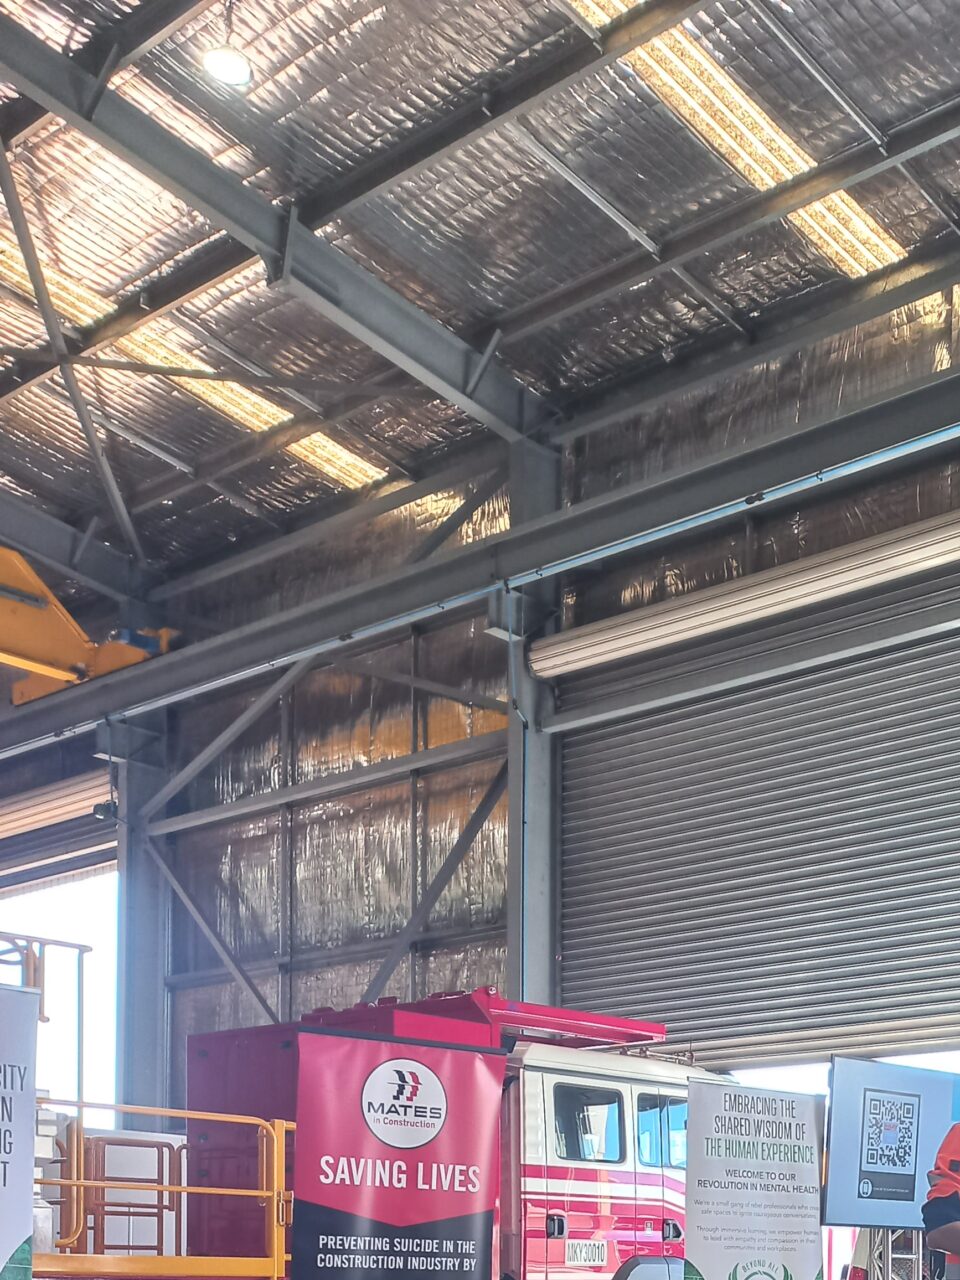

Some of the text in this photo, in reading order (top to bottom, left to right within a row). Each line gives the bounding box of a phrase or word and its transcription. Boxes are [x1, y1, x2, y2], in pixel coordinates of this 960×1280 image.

[0, 1064, 27, 1092] ITY
[367, 1101, 442, 1120] MATES
[724, 1092, 796, 1118] EMBRACING THE
[383, 1117, 436, 1129] Construction
[714, 1115, 806, 1141] SHARED WISDOM OF
[704, 1137, 814, 1164] THE HUMAN EXPERIENCE
[319, 1155, 480, 1193] SAVING LIVES
[726, 1169, 796, 1182] WELCOME TO OUR
[697, 1180, 818, 1194] REVOLUTION IN MENTAL HEALTH
[319, 1235, 476, 1254] PREVENTING SUICIDE IN THE
[567, 1242, 604, 1263] MKY30010
[317, 1254, 476, 1272] CONSTRUCTION INDUSTRY BY
